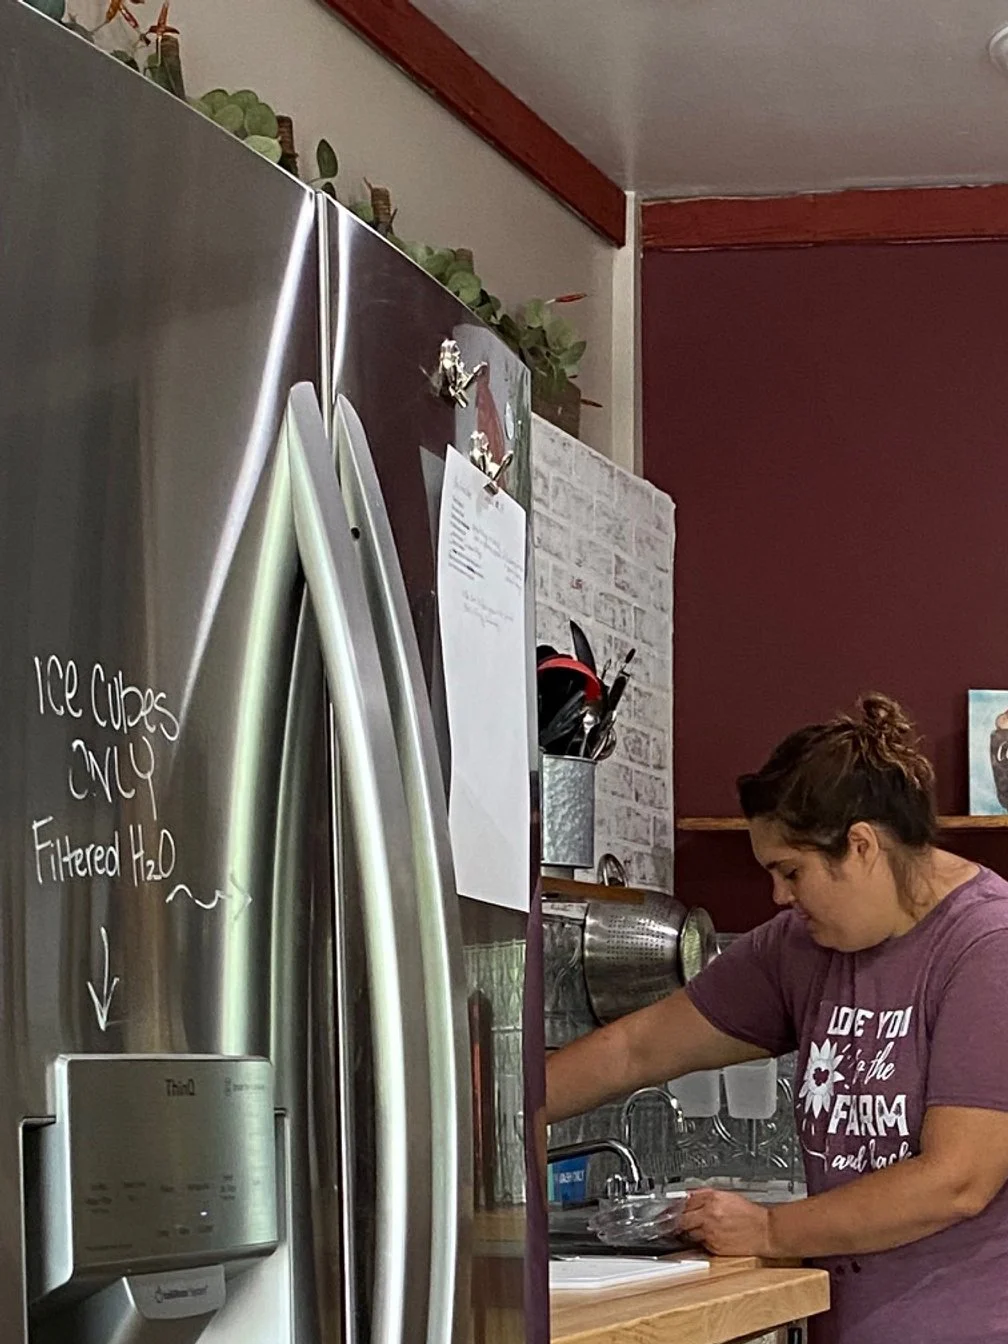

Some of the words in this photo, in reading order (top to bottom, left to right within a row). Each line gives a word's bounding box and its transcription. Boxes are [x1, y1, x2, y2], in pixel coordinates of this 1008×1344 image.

[32, 816, 121, 885] Filtered
[827, 1006, 875, 1037] LOE
[864, 1041, 896, 1085] the
[827, 1094, 910, 1137] FARM
[831, 1145, 868, 1173] and
